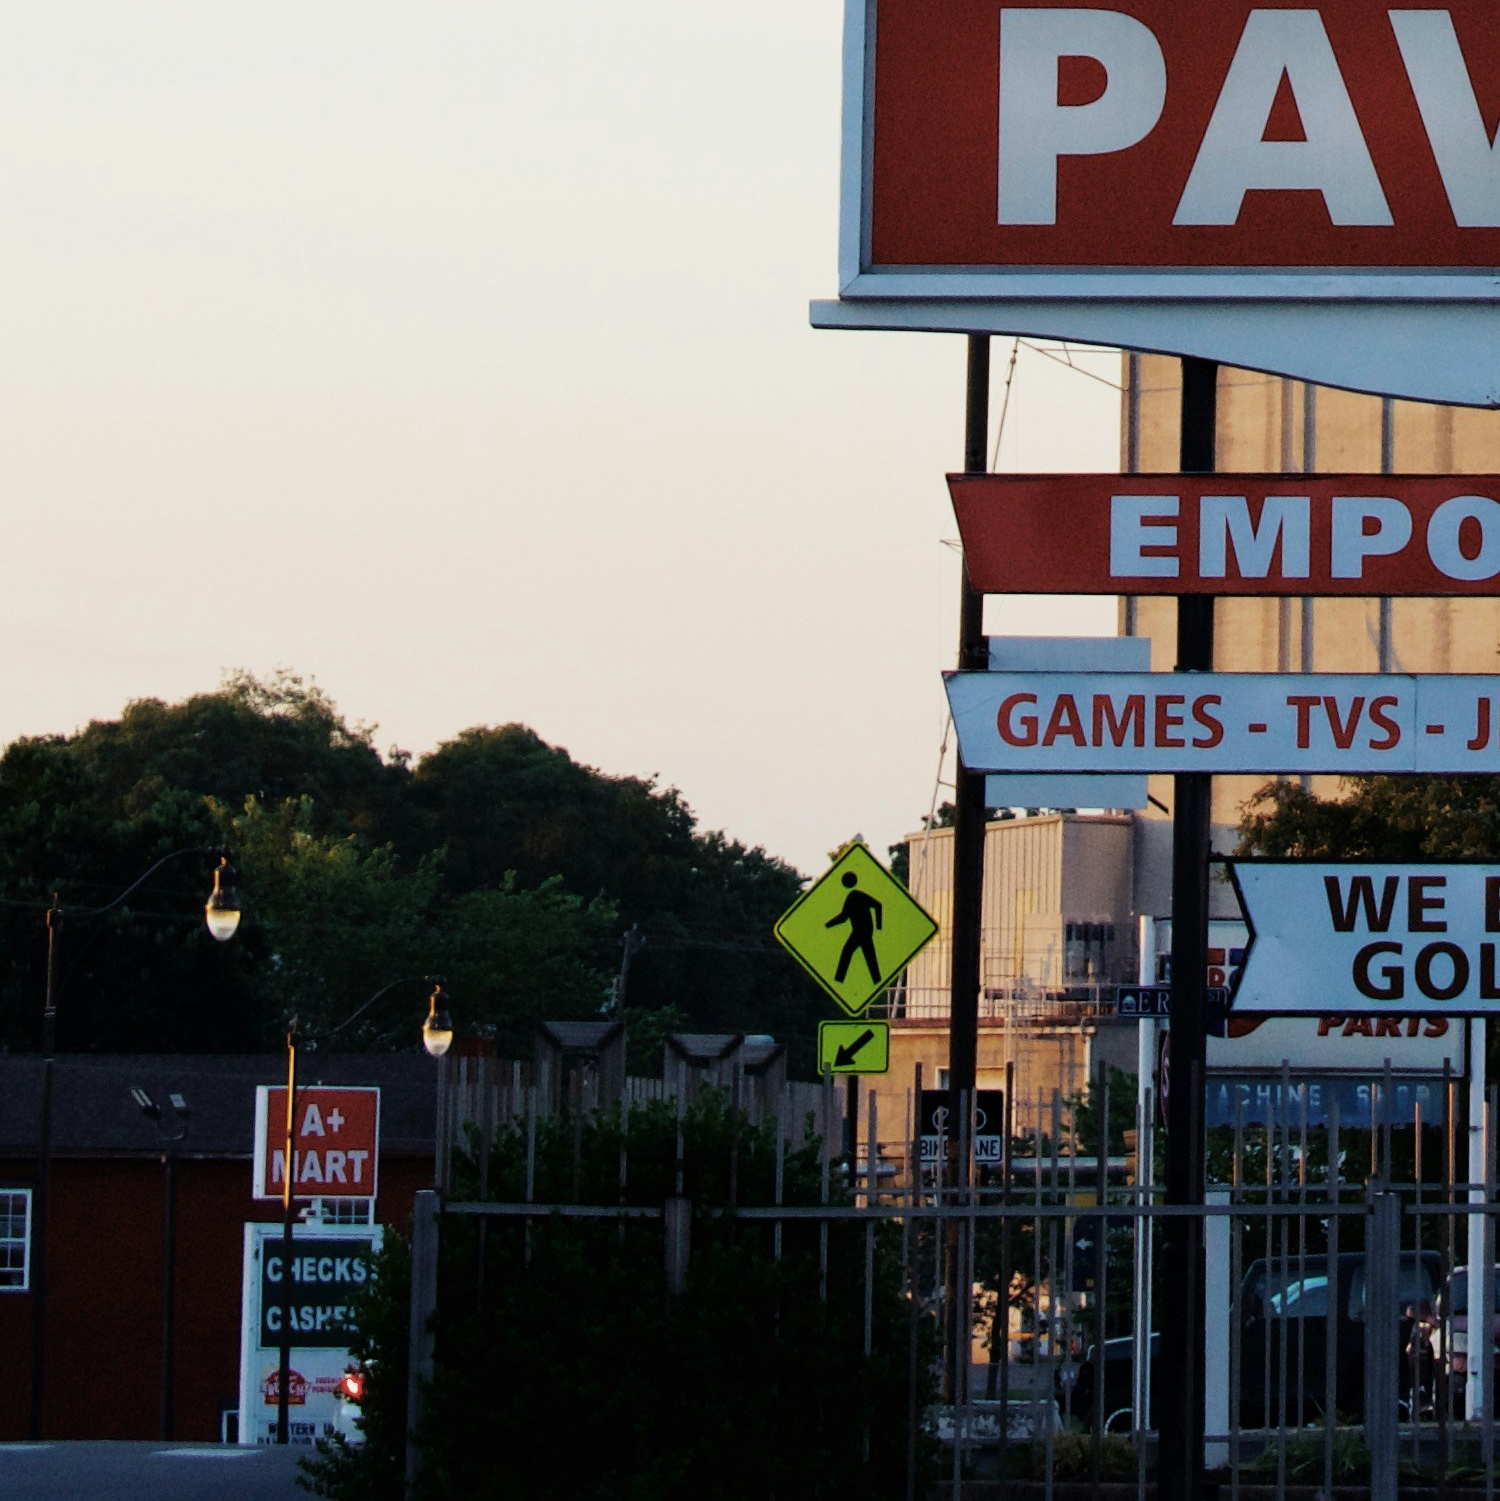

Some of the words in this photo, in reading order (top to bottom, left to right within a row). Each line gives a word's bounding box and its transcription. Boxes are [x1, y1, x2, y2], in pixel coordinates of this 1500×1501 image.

[996, 692, 1225, 750] GAMES
[1286, 695, 1401, 751] TVS
[1323, 874, 1449, 934] WE
[1205, 1082, 1322, 1107] ACHINE
[300, 1103, 345, 1137] A+
[271, 1149, 369, 1183] MART
